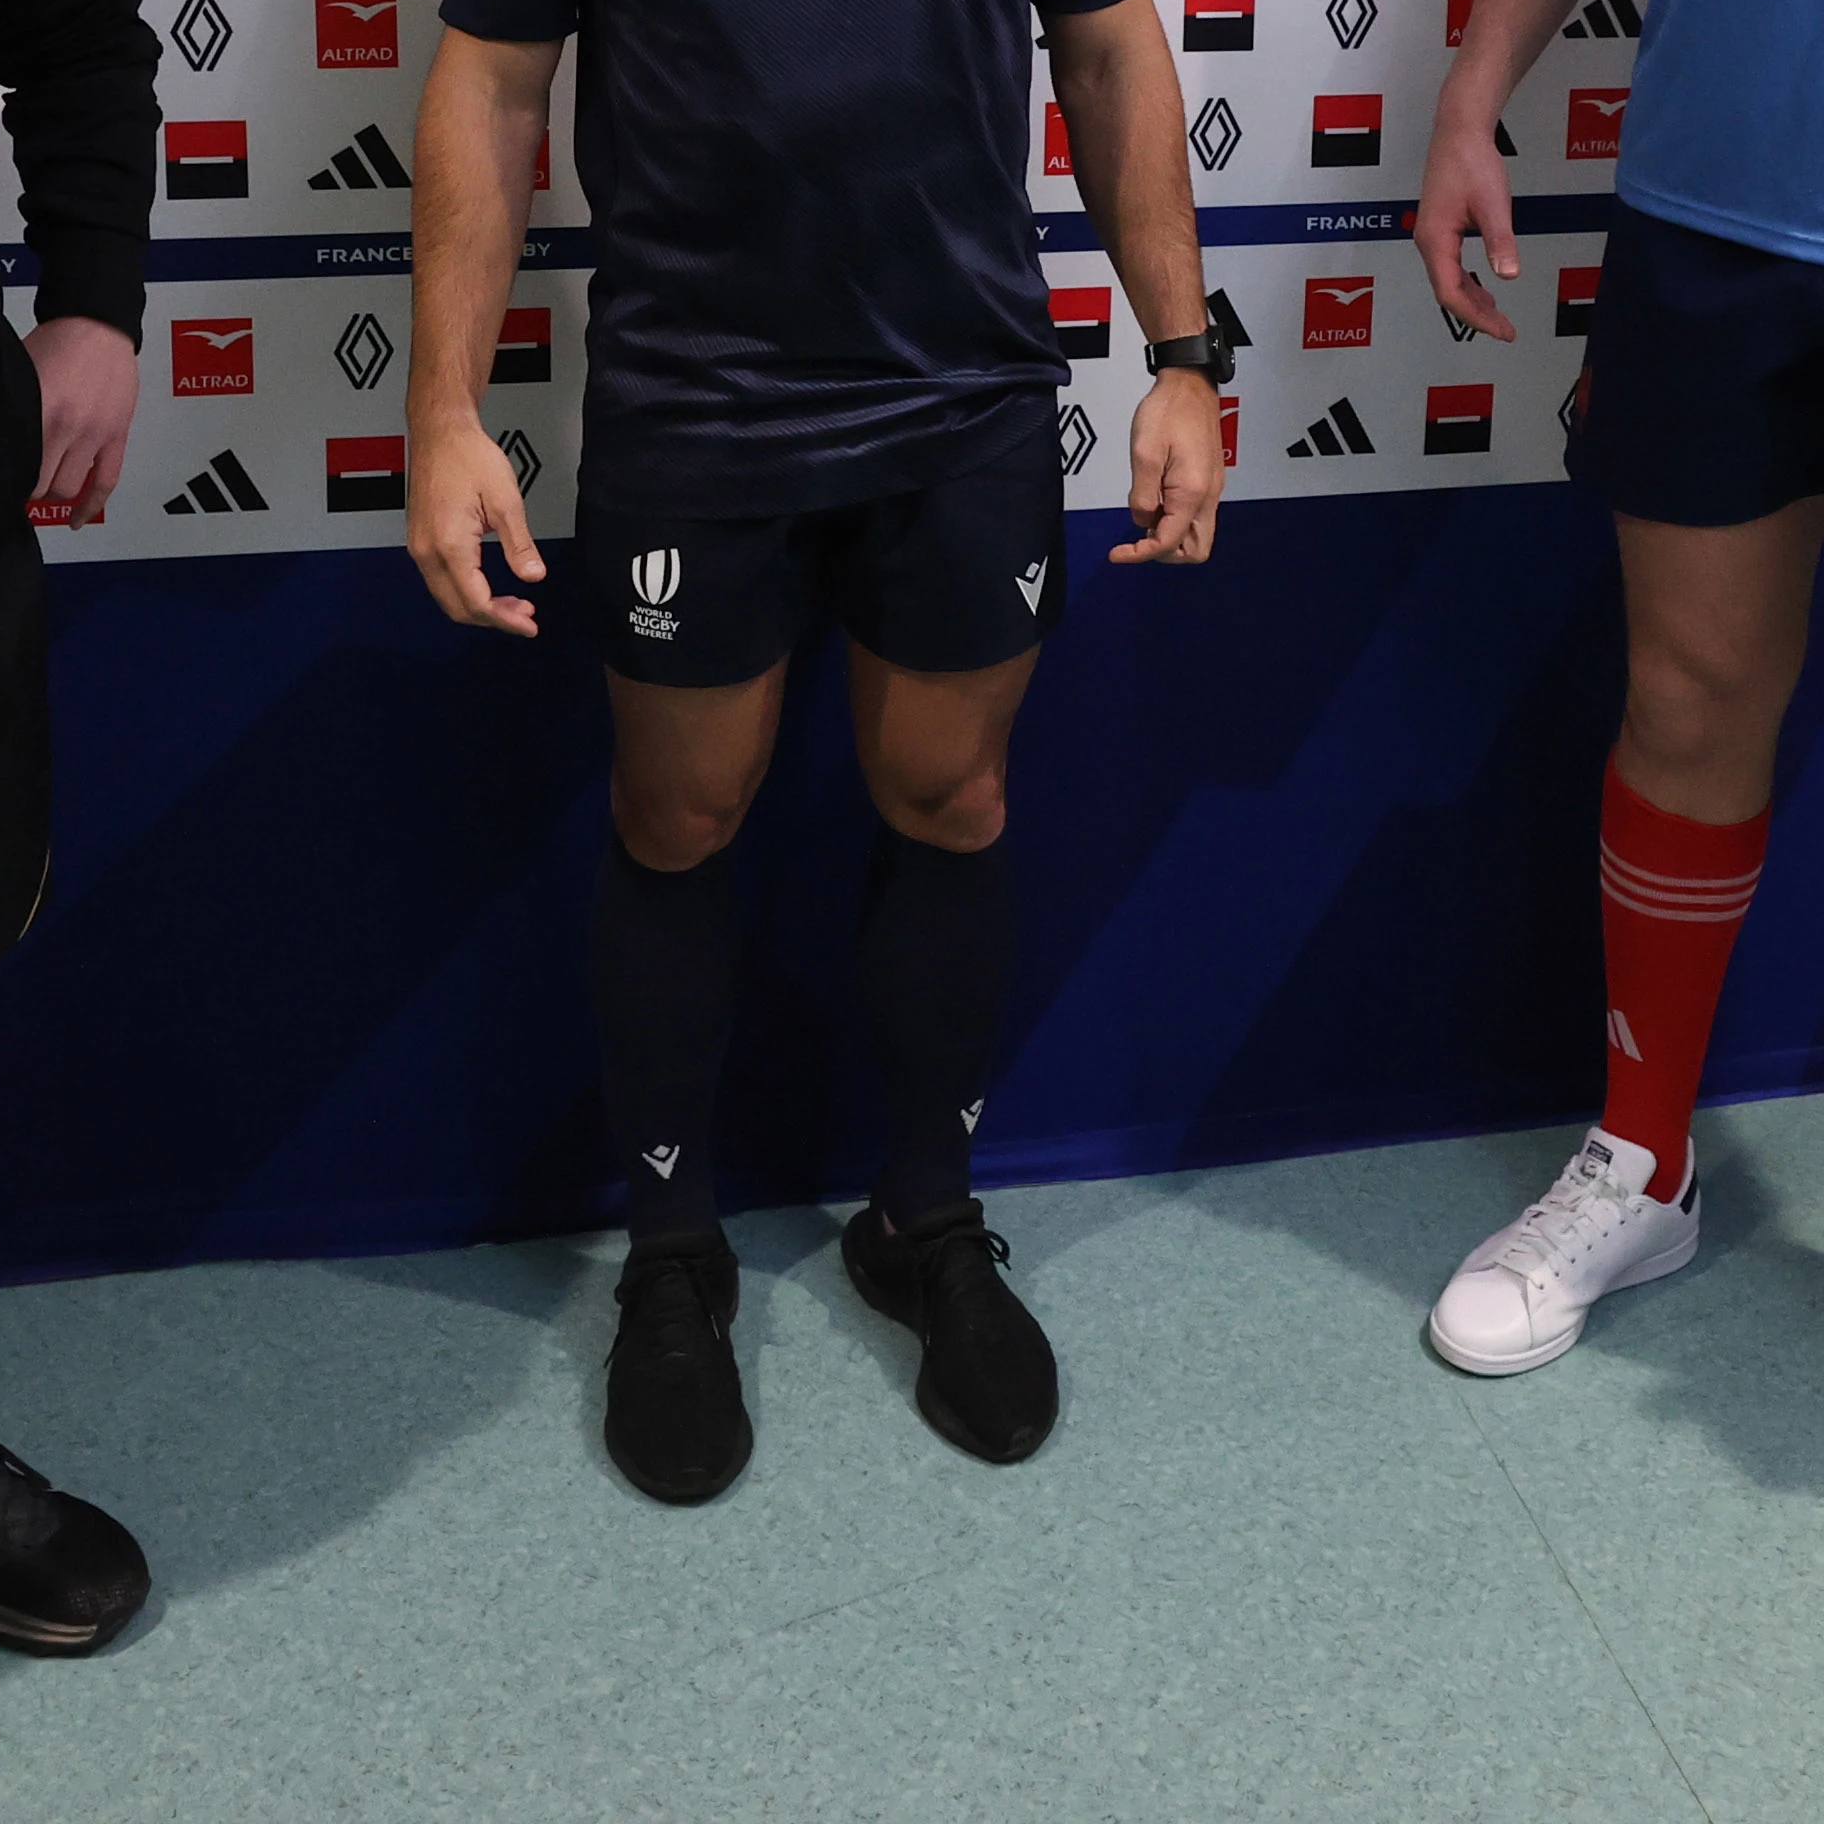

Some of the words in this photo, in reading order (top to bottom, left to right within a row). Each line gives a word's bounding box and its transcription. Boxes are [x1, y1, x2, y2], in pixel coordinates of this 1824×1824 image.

[321, 47, 393, 62] ALTRAD
[1570, 140, 1619, 154] ALTRA
[1306, 214, 1392, 231] FRANCE
[316, 246, 414, 264] FRANCE
[1306, 328, 1367, 343] ALTRAD
[177, 374, 249, 389] ALTRAD
[27, 505, 73, 519] ALTR
[634, 605, 673, 620] WORLD
[629, 611, 681, 633] RUGBY
[634, 624, 674, 641] REFEREE
